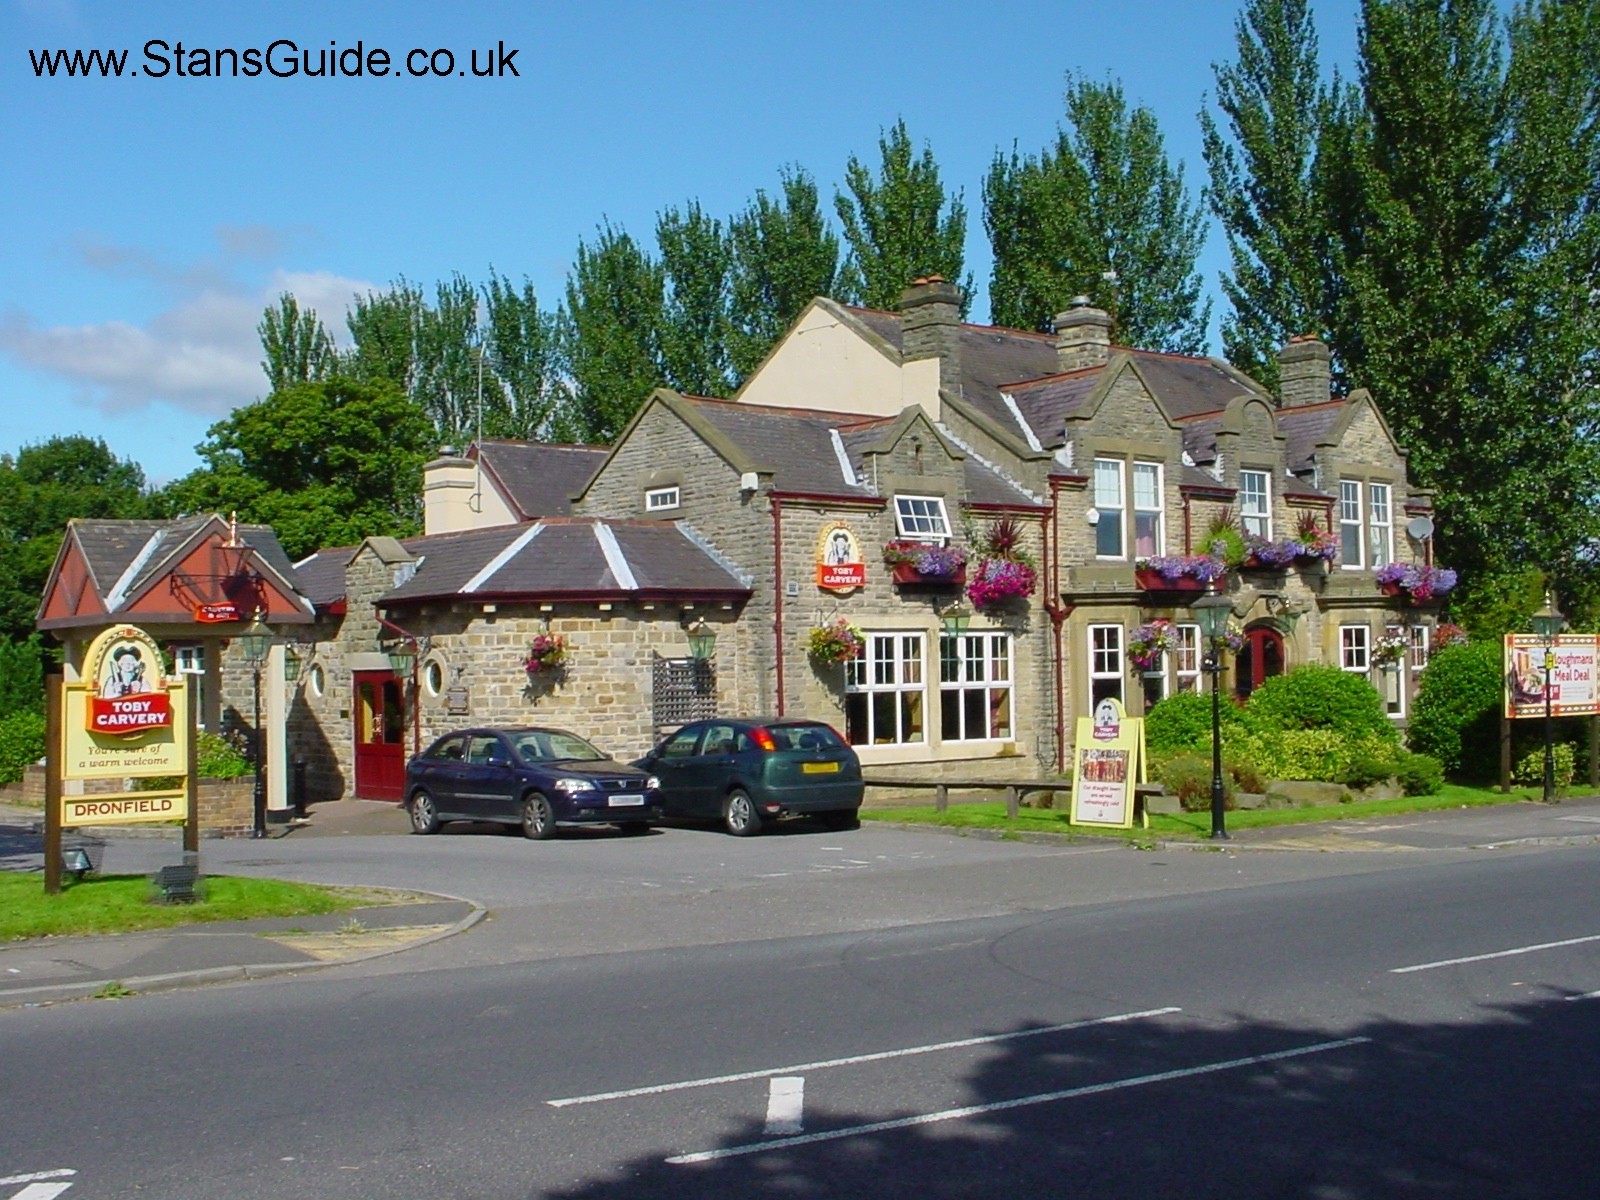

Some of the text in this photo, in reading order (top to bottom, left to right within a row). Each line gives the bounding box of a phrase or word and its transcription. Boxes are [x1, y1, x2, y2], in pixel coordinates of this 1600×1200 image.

[832, 567, 854, 575] TOBY
[823, 575, 862, 584] CARVERY
[1554, 668, 1590, 681] Meal Deal
[112, 701, 151, 713] TOBY
[96, 713, 167, 726] CARVERY
[124, 746, 147, 754] sure
[150, 744, 161, 755] of
[89, 759, 120, 768] warm
[123, 757, 169, 766] welcome
[74, 799, 173, 817] DRONFIELD
